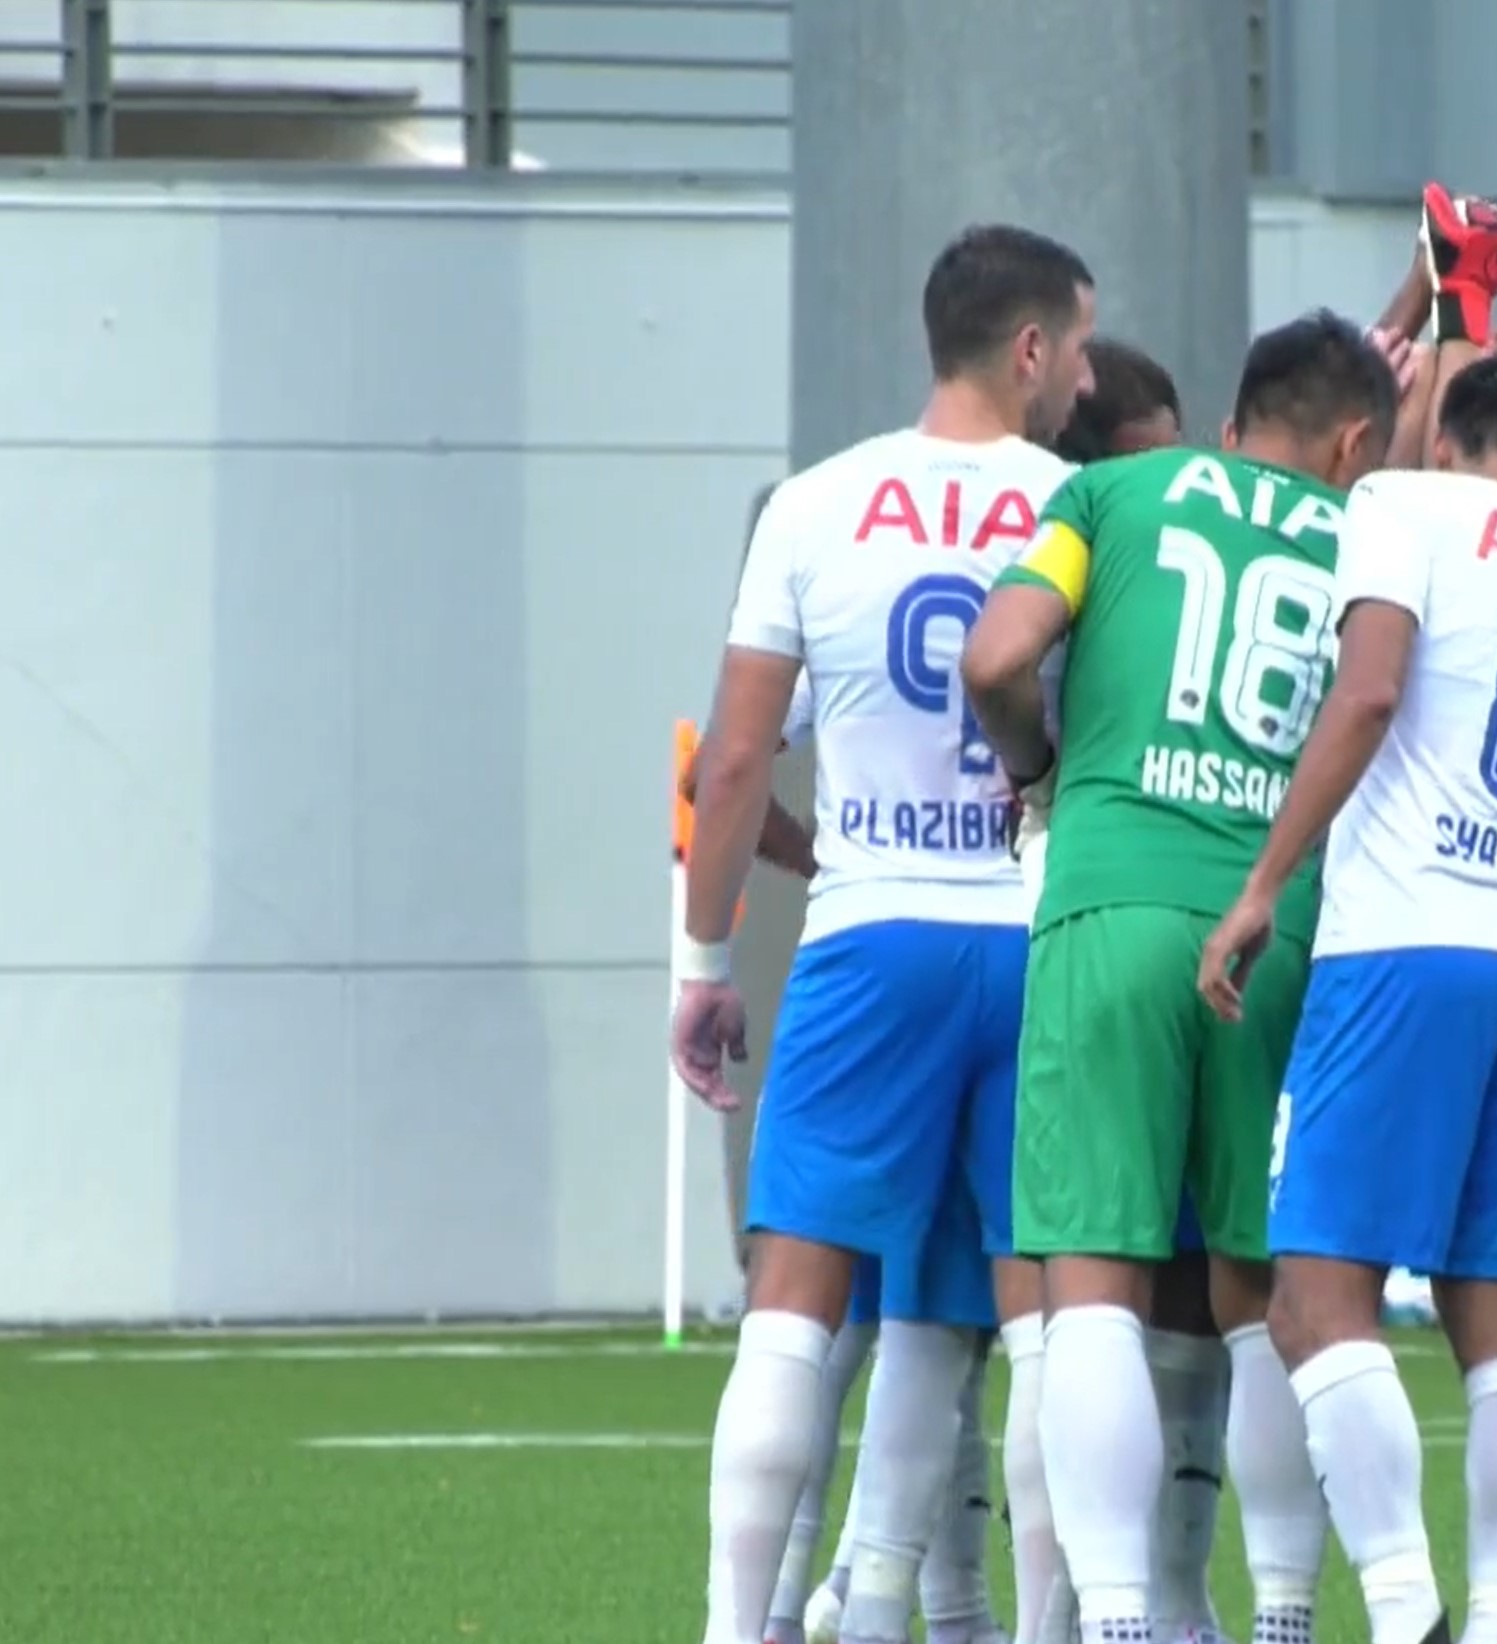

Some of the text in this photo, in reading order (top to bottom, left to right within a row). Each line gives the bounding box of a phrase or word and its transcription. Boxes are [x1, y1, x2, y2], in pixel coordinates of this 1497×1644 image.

[854, 478, 1037, 550] AIA
[1163, 455, 1345, 540] AIA
[886, 573, 996, 774] 9
[1157, 524, 1345, 755] 18
